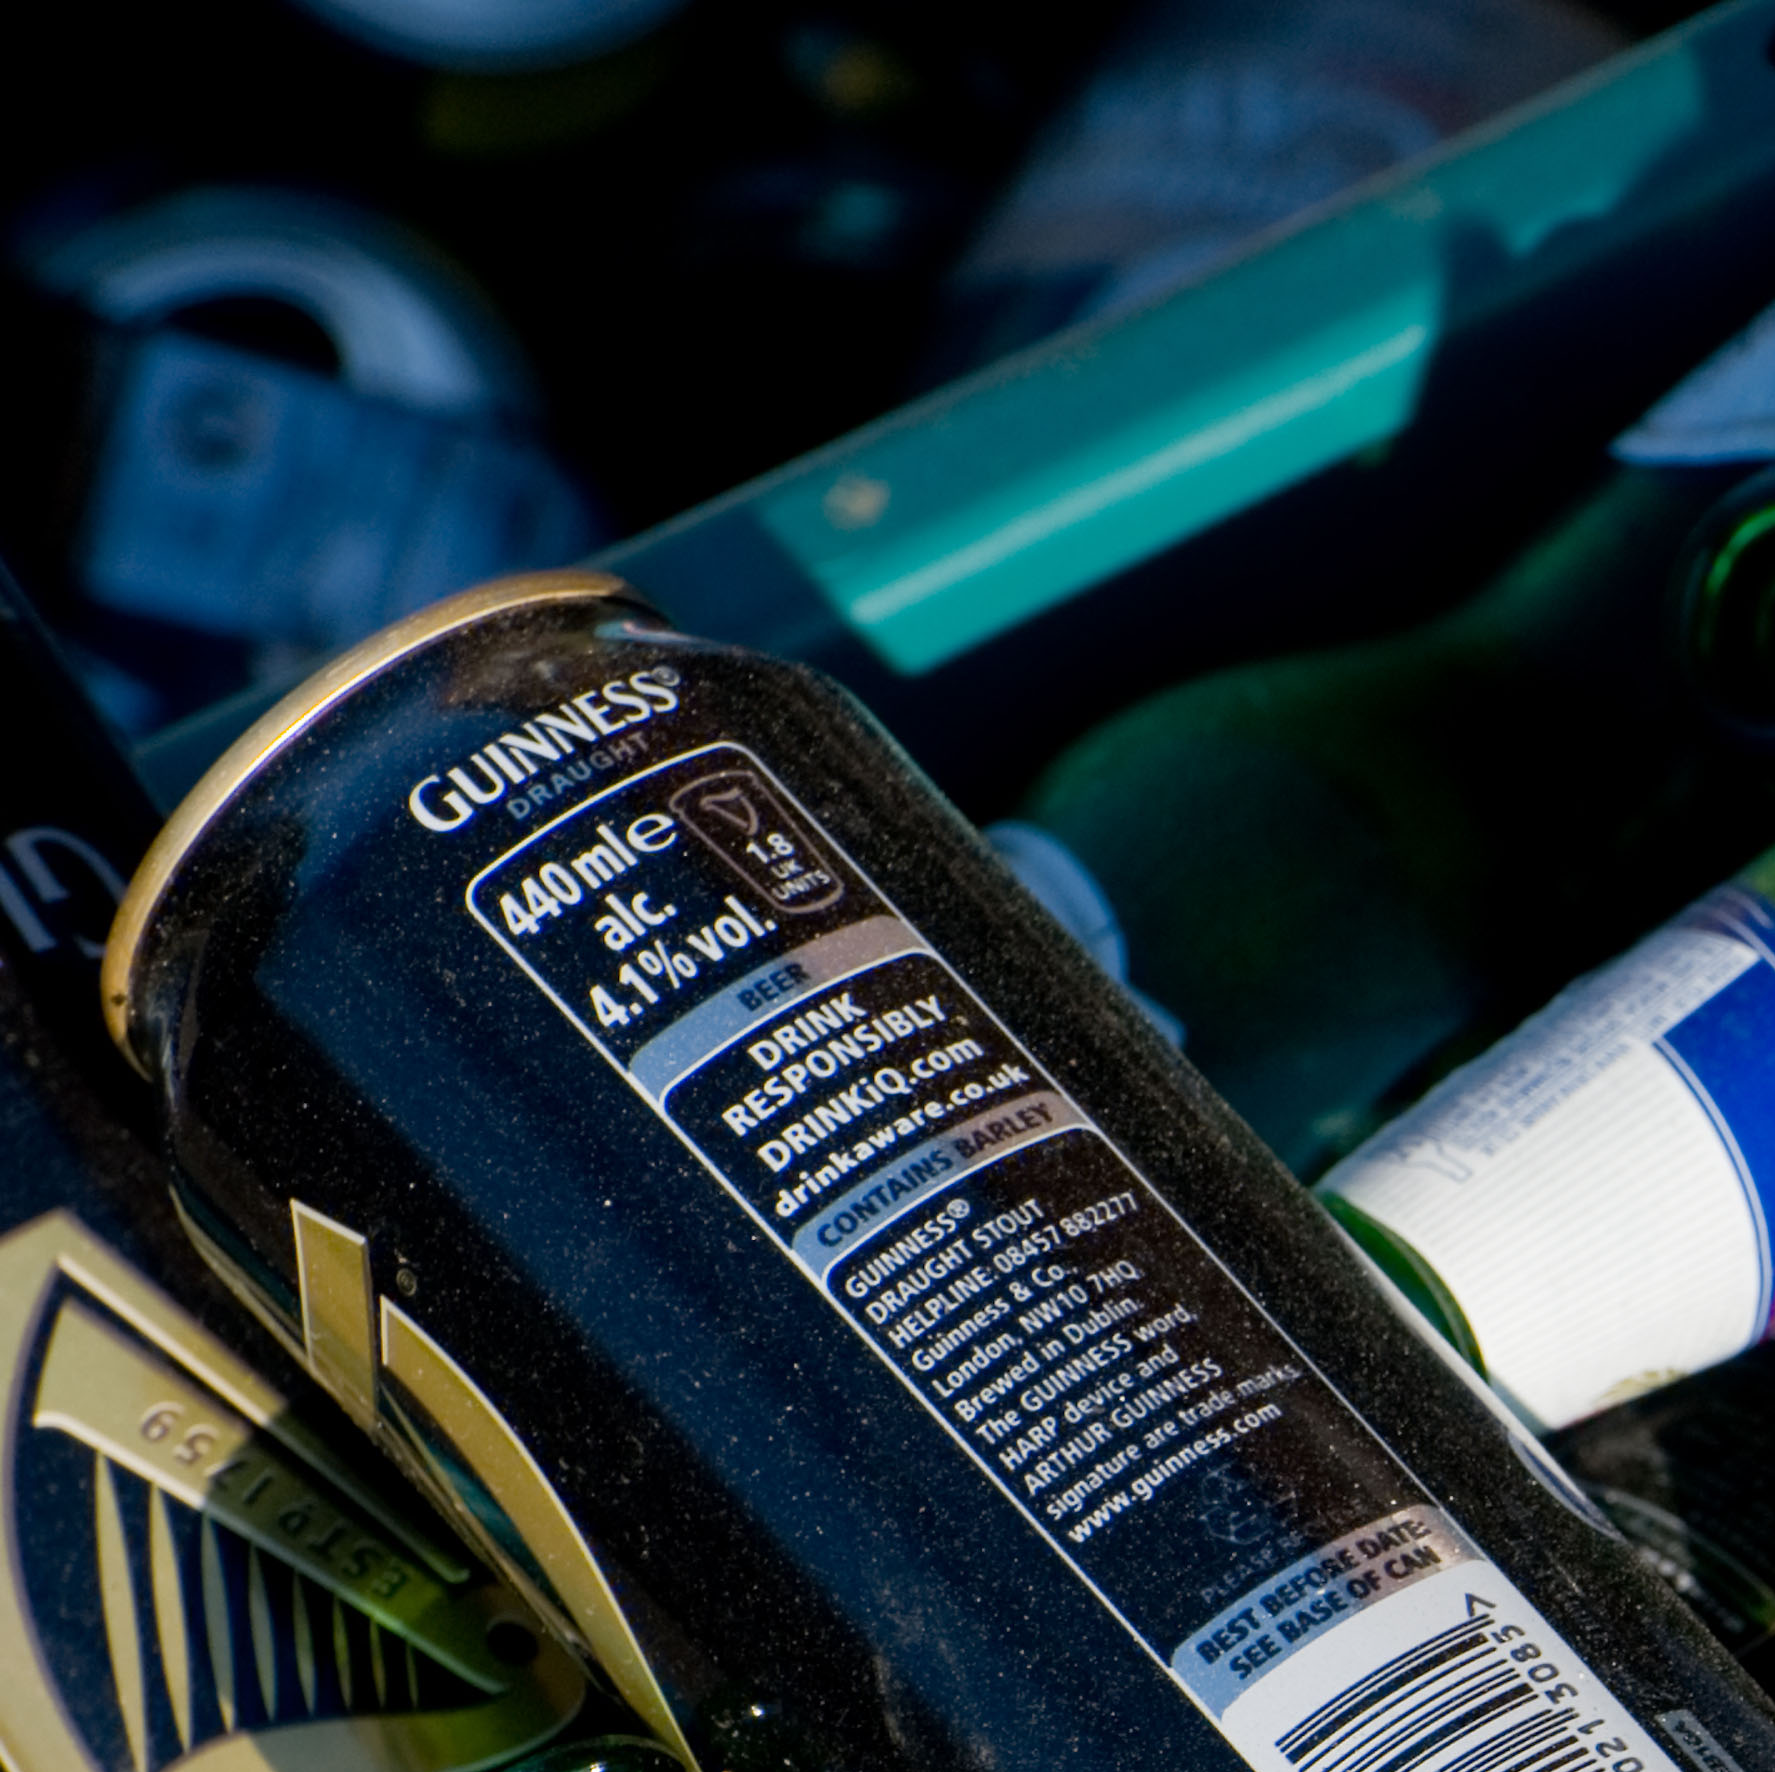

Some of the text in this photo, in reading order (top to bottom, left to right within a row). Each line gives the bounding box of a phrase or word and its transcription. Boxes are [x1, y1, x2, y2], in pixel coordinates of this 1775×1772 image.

[506, 734, 652, 821] DRAUGHT
[747, 831, 796, 865] 1.8
[770, 857, 802, 881] UK
[589, 897, 779, 1031] 4.1% vol.
[594, 893, 679, 952] alc.
[737, 961, 812, 1013] BEER
[748, 992, 868, 1073] DRINK
[721, 994, 950, 1139] RESPONSIBLY
[756, 1035, 986, 1174] DRINKiQ.com
[775, 1062, 1031, 1219] drinkaware.co.uk
[815, 1102, 1054, 1249] CONTAINS BARLEY
[864, 1198, 1046, 1326] DRAUGHT STOUT
[992, 1224, 1063, 1274] 08457
[1059, 1191, 1139, 1238] 882277
[910, 1280, 1034, 1373] Guinness &
[930, 1283, 1089, 1399] London, NW10
[953, 1295, 1145, 1423] Brewed in Dublin.
[975, 1408, 1023, 1446] The
[1019, 1332, 1133, 1413] GUINNESS
[998, 1343, 1181, 1473] HARP device and
[1022, 1356, 1224, 1497] ARTHUR GUINNESS
[138, 1400, 272, 1507] 1759
[1045, 1440, 1143, 1522] signature
[1142, 1421, 1180, 1451] are
[1178, 1388, 1237, 1428] trade
[1066, 1401, 1283, 1545] www.guinness.com
[1196, 1616, 1261, 1665] BEST
[1257, 1551, 1357, 1616] BEFORE
[1229, 1545, 1443, 1681] SEE BASE OF CAN
